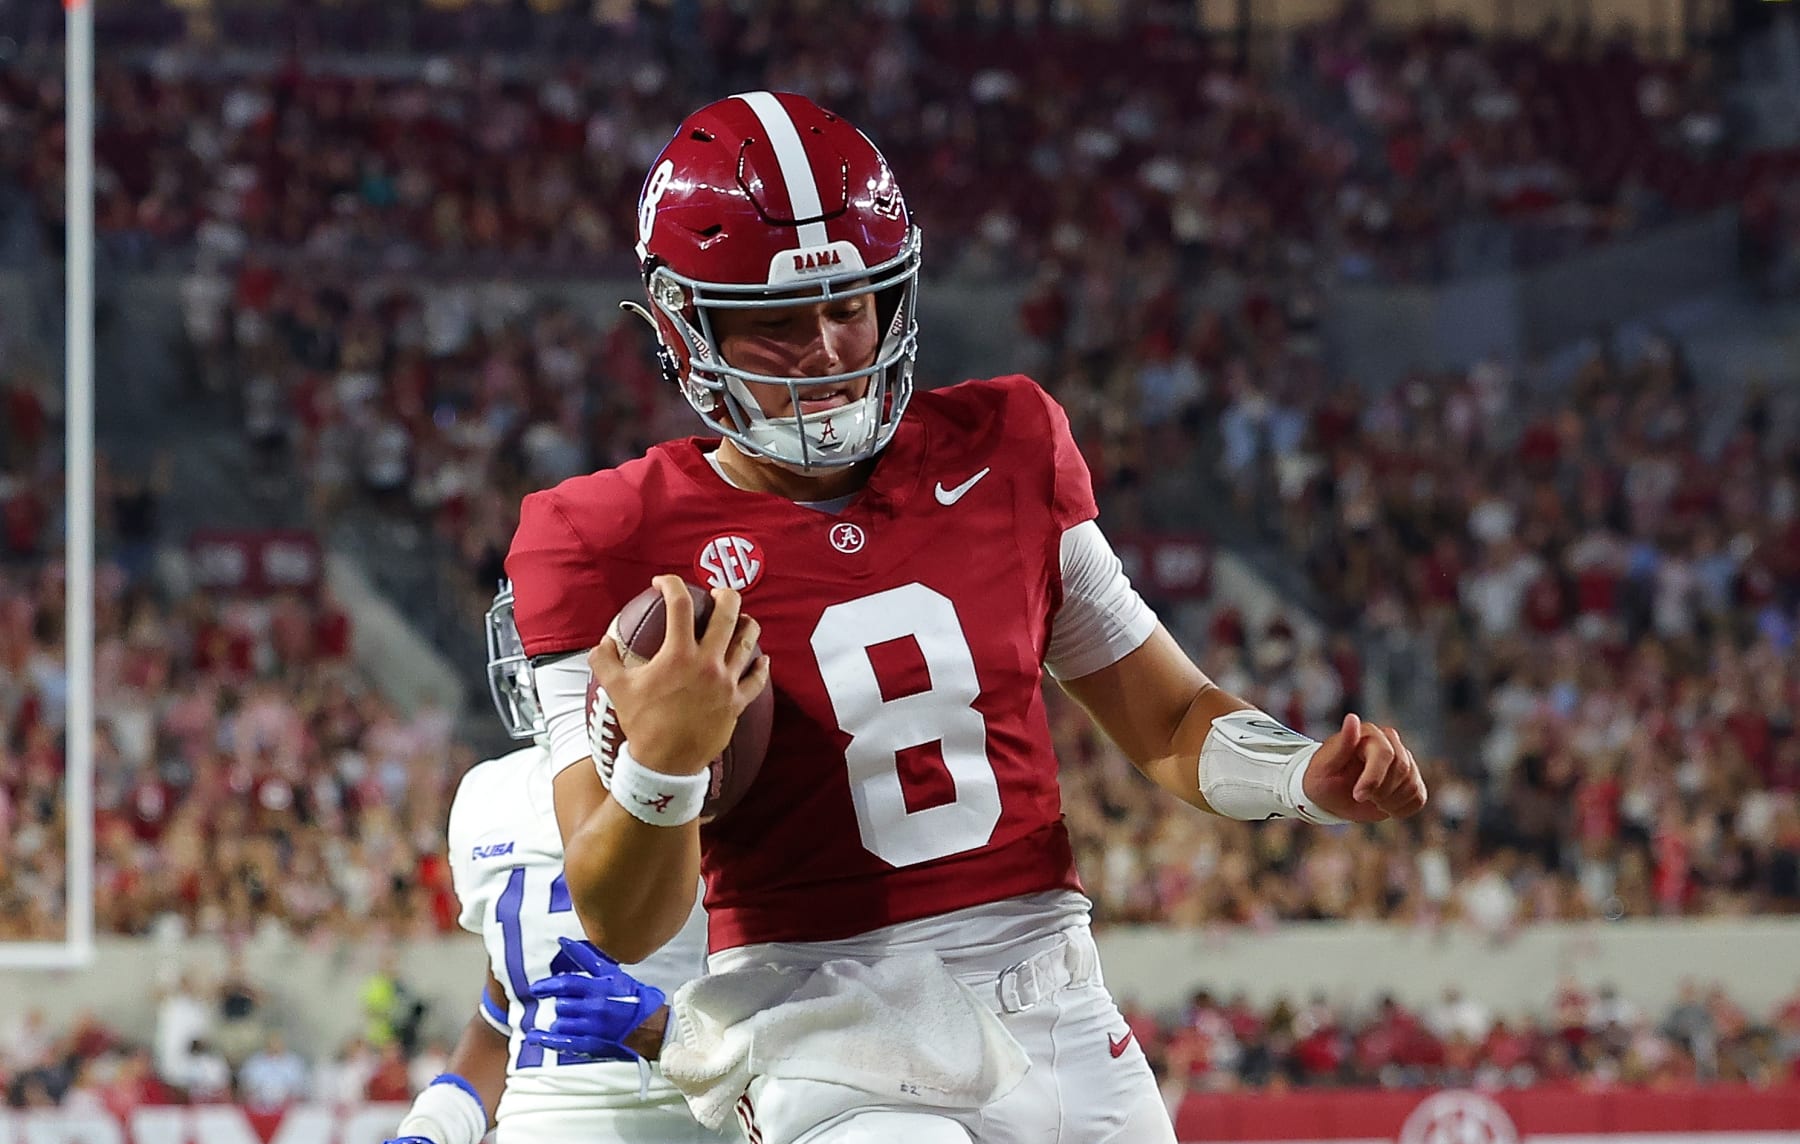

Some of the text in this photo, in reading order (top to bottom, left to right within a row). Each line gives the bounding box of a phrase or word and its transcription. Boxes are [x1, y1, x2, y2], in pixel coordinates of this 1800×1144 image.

[638, 159, 674, 245] 8
[793, 249, 841, 270] BAMA
[700, 535, 761, 591] SEC
[810, 582, 1002, 868] 8
